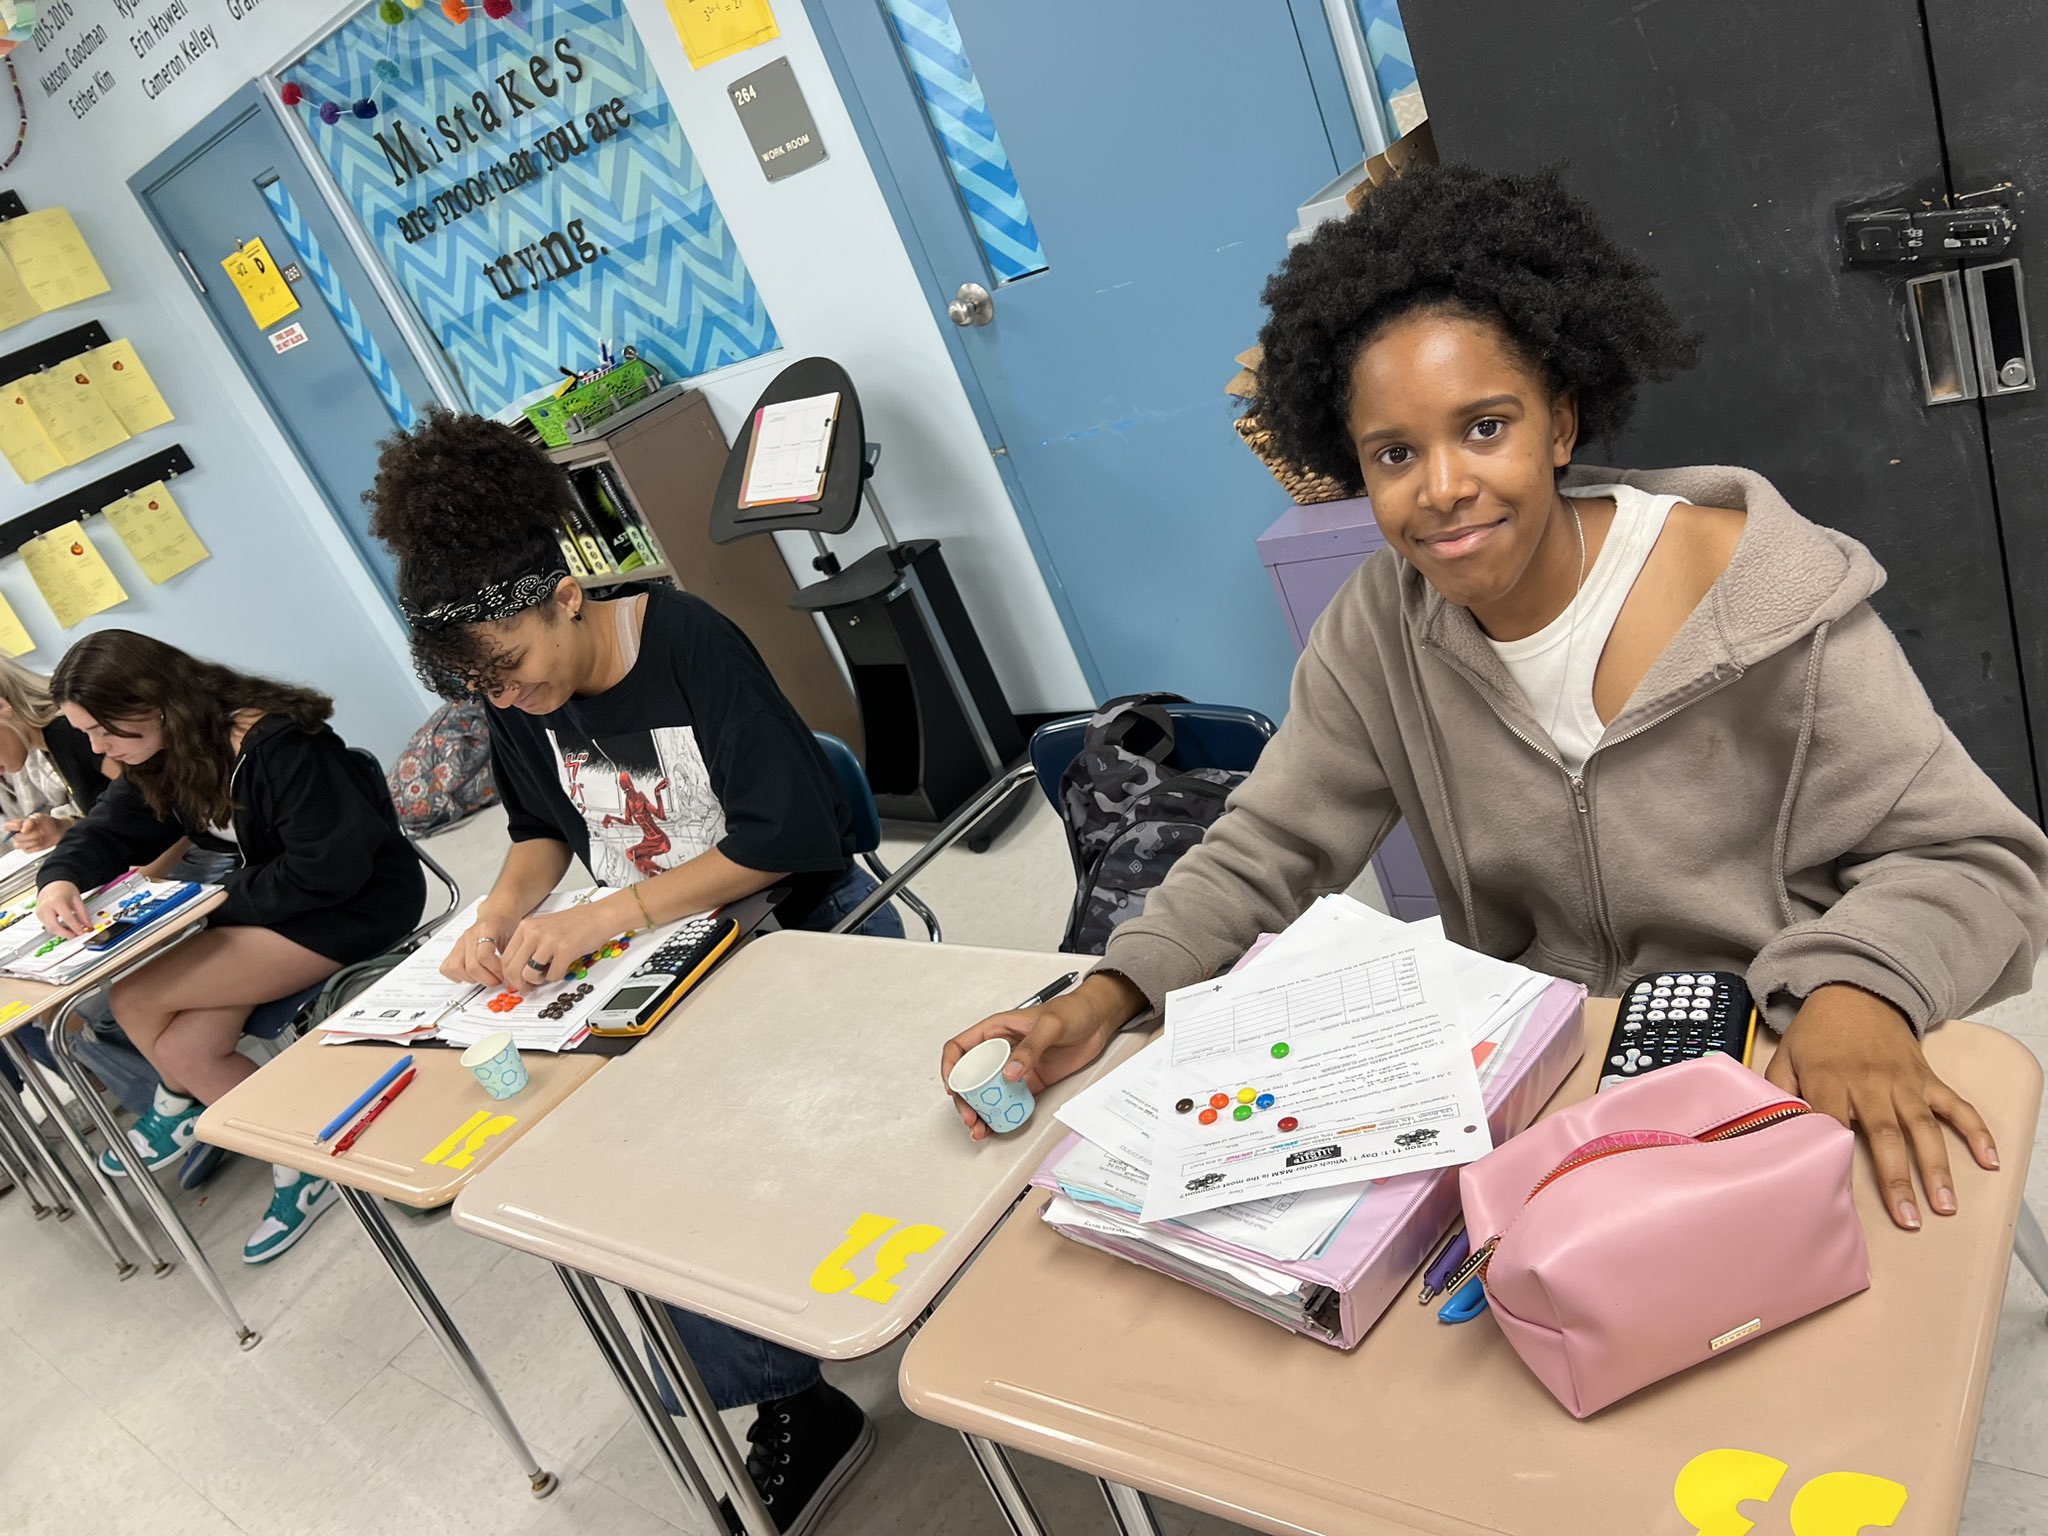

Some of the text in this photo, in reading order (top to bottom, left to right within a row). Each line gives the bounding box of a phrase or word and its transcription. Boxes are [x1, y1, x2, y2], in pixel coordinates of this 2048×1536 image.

[113, 0, 141, 19] Rya
[226, 0, 260, 21] Gra
[32, 0, 74, 52] 2015-2016
[65, 24, 108, 69] Goodman
[129, 29, 156, 59] Erin
[141, 24, 219, 100] Cameron Kelley
[68, 70, 116, 120] Esther Kim
[735, 85, 757, 106] 264
[373, 37, 584, 187] Mistakes
[761, 134, 811, 163] WORK ROOM
[396, 96, 632, 244] are proof that you are
[482, 218, 610, 301] trying.
[421, 1110, 519, 1170] 31
[1404, 1140, 1438, 1151] Lesson
[1319, 1157, 1346, 1167] Which
[1360, 1151, 1378, 1160] Day
[1380, 1147, 1401, 1156] 11.1:
[1271, 1167, 1292, 1177] M&M
[1295, 1162, 1317, 1172] color
[1222, 1179, 1243, 1188] most
[1245, 1175, 1259, 1183] the
[1179, 1184, 1220, 1199] common?
[810, 1212, 947, 1305] 32
